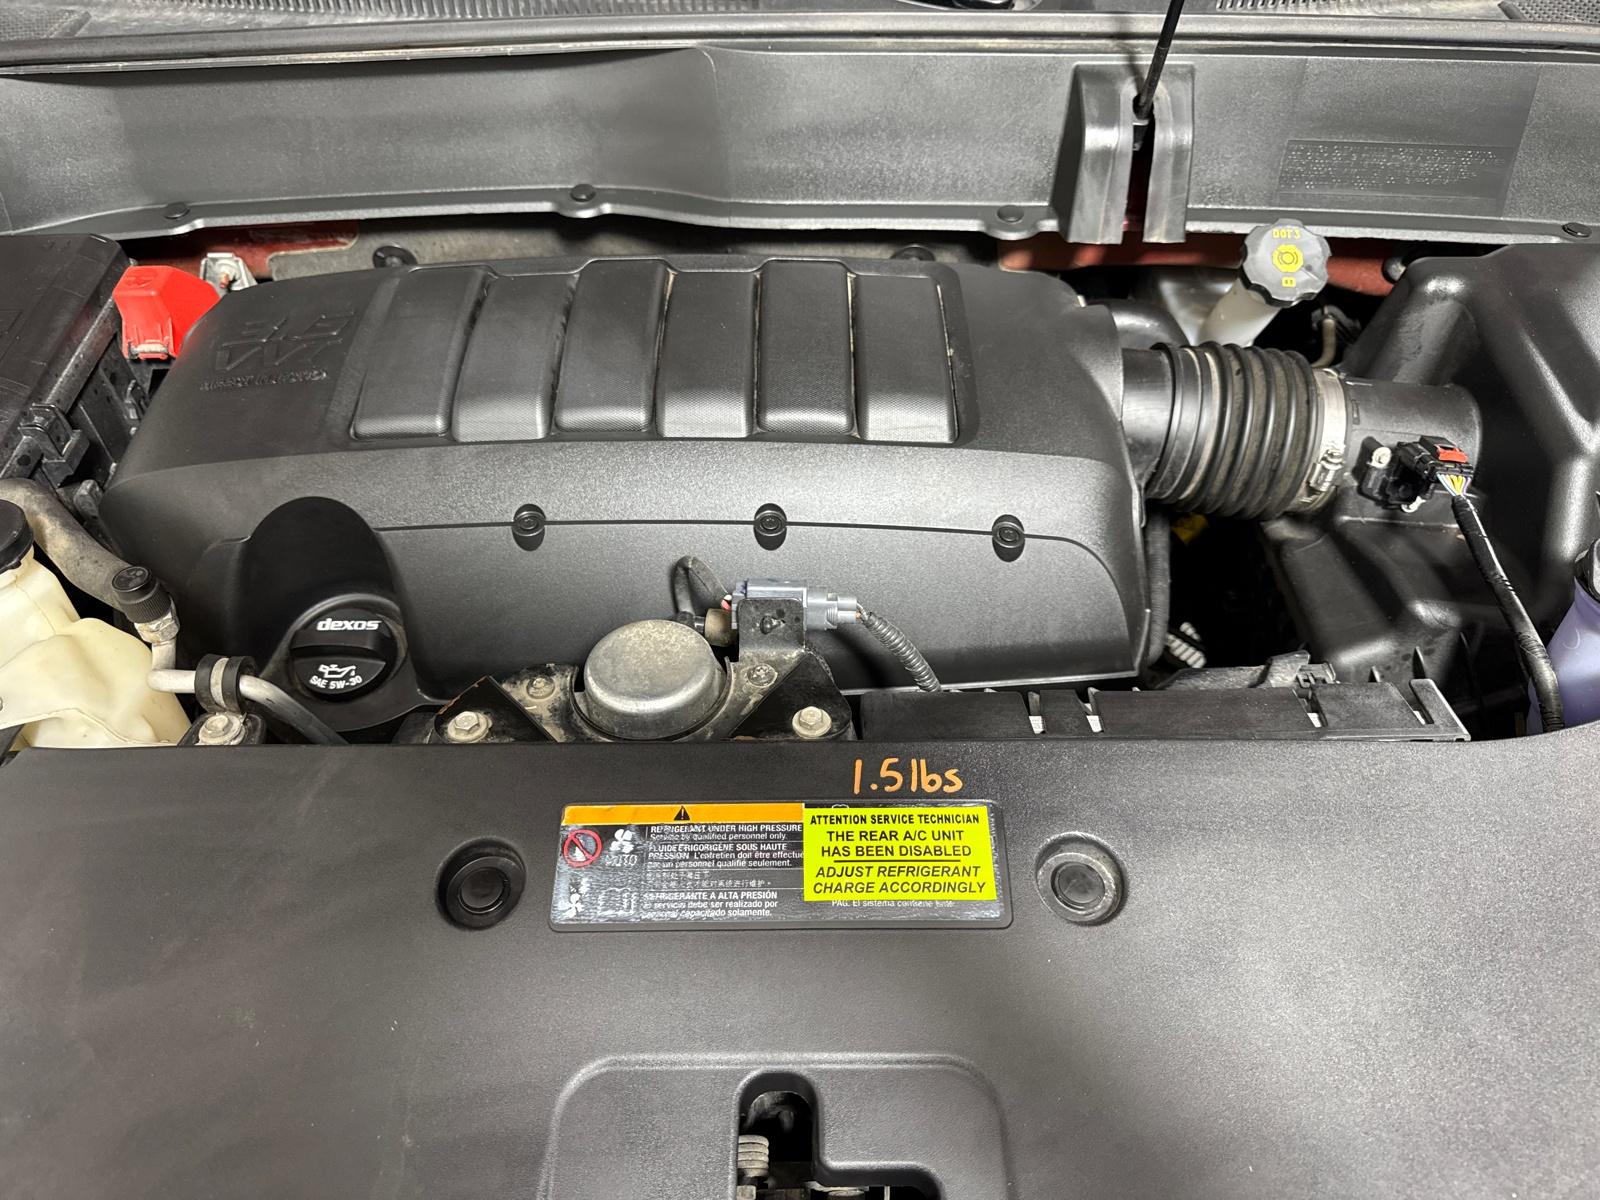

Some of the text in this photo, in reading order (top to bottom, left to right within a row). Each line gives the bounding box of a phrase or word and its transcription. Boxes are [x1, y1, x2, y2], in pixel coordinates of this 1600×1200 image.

[1272, 228, 1293, 239] DOT
[316, 618, 382, 631] dexos
[309, 675, 363, 689] SAE 5W-30
[810, 813, 980, 825] ATTENTION SERVICE TECHNICIAN
[707, 824, 736, 833] UNDER
[739, 824, 758, 832] HIGH
[760, 824, 803, 832] PRESSURE
[692, 833, 727, 842] qualified
[728, 833, 767, 841] personnel
[769, 832, 788, 841] only.
[827, 830, 964, 842] THE REAR A/C UNIT
[736, 843, 758, 851] SOUS
[760, 843, 788, 851] HAUTE
[821, 845, 972, 857] HAS BEEN DISABLED
[737, 851, 752, 859] doit
[754, 850, 770, 859] être
[675, 860, 715, 870] personnel
[748, 859, 792, 868] seulement.
[816, 865, 981, 878] ADJUST REFRIGERANT
[813, 881, 986, 894] CHARGE ACCORDINGLY
[710, 891, 717, 900] A
[718, 891, 739, 900] ALTA
[741, 889, 777, 900] PRESIÓN
[710, 901, 724, 909] ser
[725, 900, 763, 909] realizado
[765, 901, 778, 910] por
[862, 899, 895, 907] sistema
[728, 908, 772, 917] solamente.
